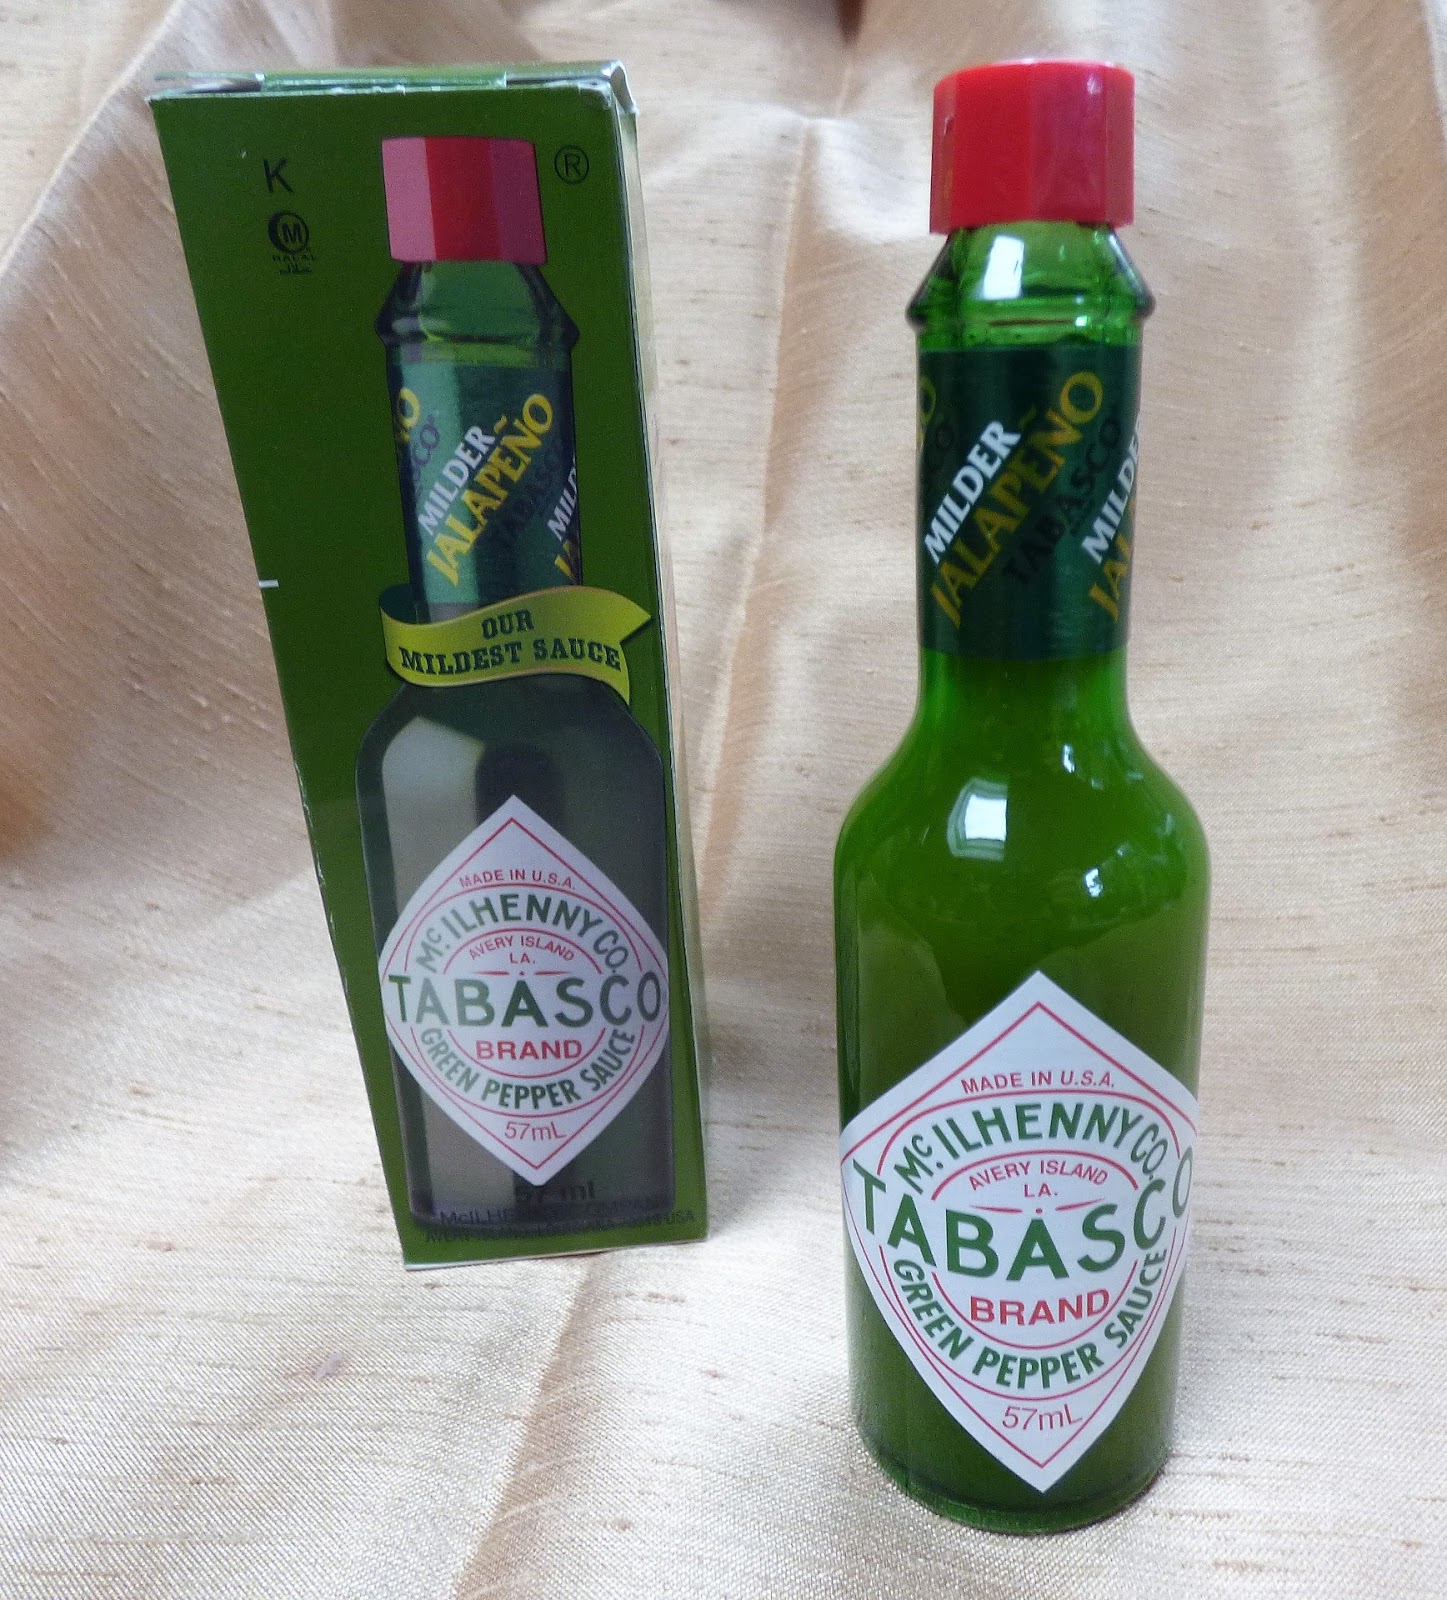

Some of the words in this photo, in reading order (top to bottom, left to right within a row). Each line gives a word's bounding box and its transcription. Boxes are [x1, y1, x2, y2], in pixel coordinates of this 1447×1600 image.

[263, 157, 295, 194] K
[416, 425, 497, 537] MILDER
[425, 392, 554, 588] JALAPEÑO
[924, 420, 1022, 564] MILDER
[930, 370, 1104, 630] JALAPEÑO
[481, 608, 535, 640] OUR
[398, 641, 523, 676] MILDEST
[532, 637, 621, 672] SAUCE
[459, 869, 504, 889] MADE
[509, 868, 526, 881] IN
[531, 870, 576, 891] U.S.A.
[469, 935, 515, 961] AVERY
[520, 935, 576, 962] ISLAND
[508, 952, 537, 965] LA.
[388, 969, 662, 1029] TABASCO
[419, 1027, 482, 1094] GREEN
[480, 1078, 583, 1110] PEPPER
[579, 1028, 636, 1093] SAUCE
[474, 1039, 583, 1061] BRAND
[960, 1072, 1024, 1095] MADE
[1030, 1070, 1053, 1086] IN
[1059, 1070, 1116, 1088] U.S.A.
[503, 1120, 568, 1142] 57mL
[968, 1161, 1030, 1191] AVERY
[1039, 1160, 1109, 1186] ISLAND
[1023, 1183, 1058, 1198] LA.
[852, 1146, 1194, 1281] TABASCO
[893, 1258, 975, 1361] GREEN
[971, 1342, 1105, 1390] PEPPER
[1103, 1248, 1168, 1350] SAUCE
[969, 1289, 1111, 1326] BRAND
[1001, 1402, 1084, 1431] 57mL
